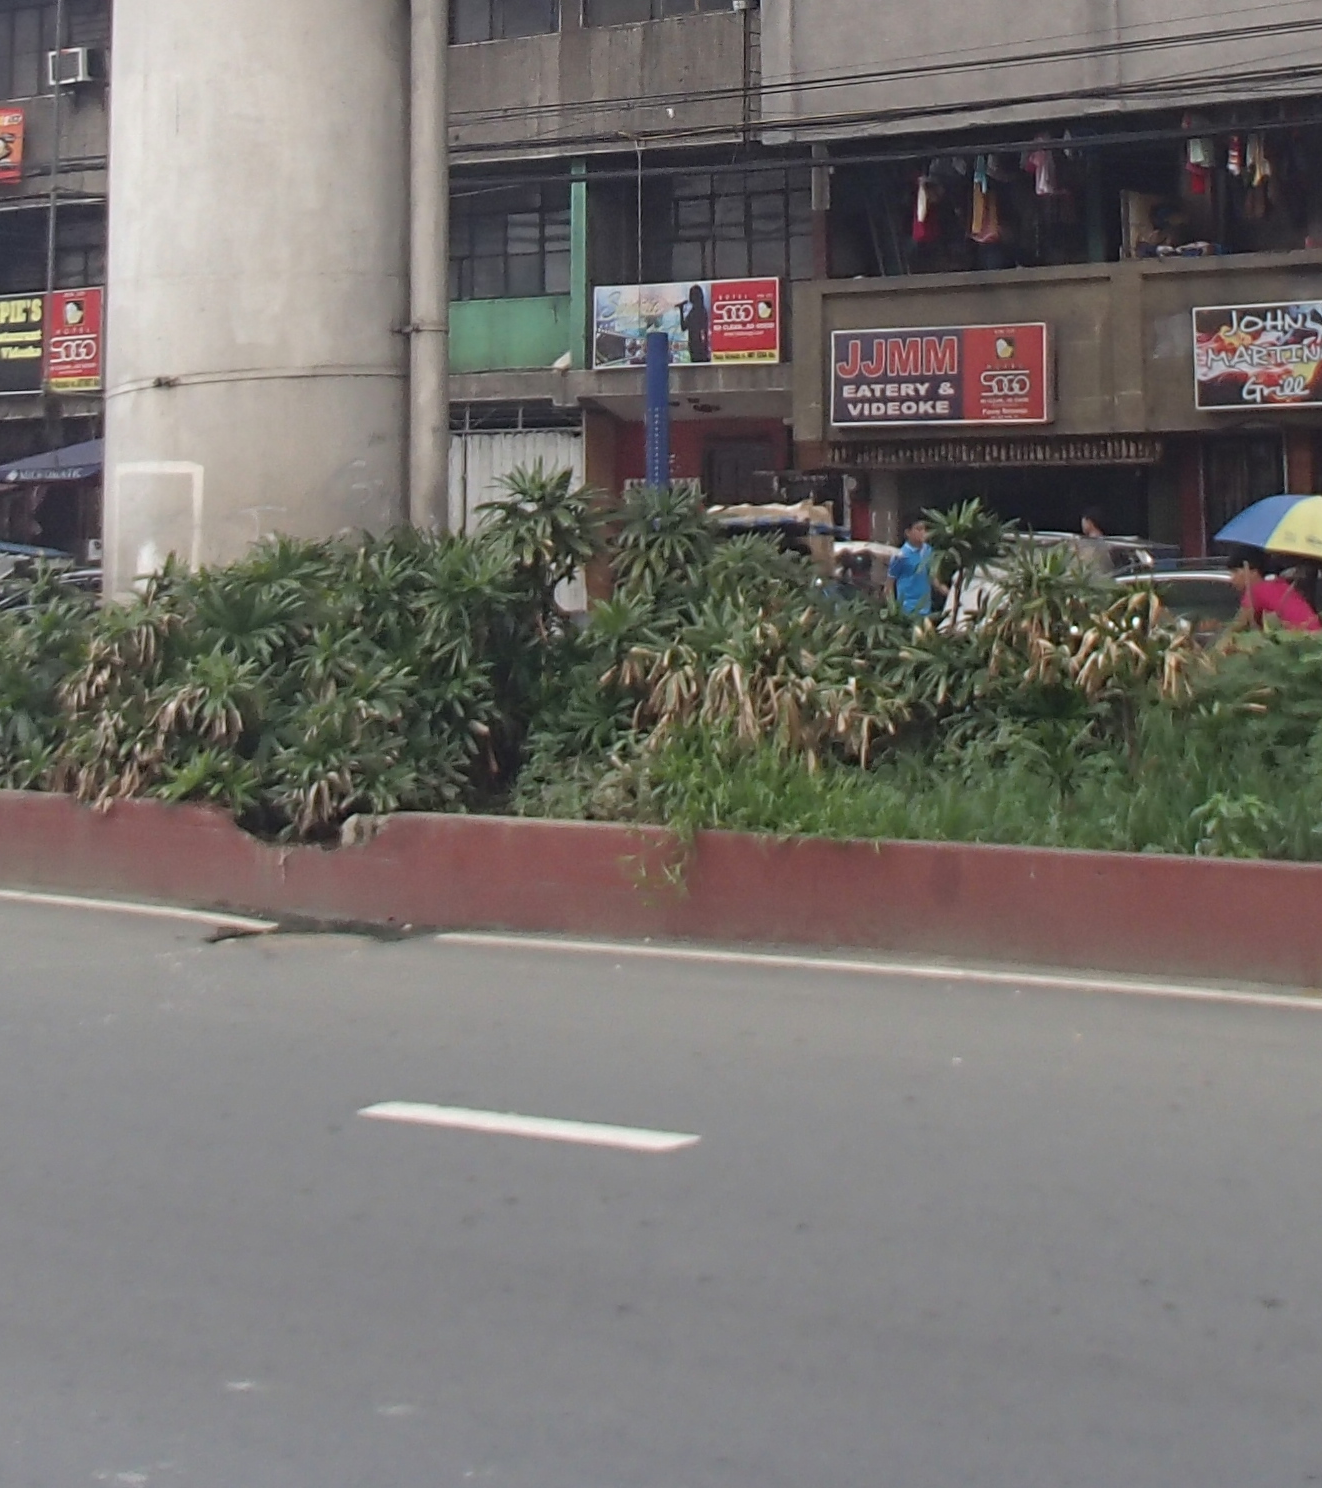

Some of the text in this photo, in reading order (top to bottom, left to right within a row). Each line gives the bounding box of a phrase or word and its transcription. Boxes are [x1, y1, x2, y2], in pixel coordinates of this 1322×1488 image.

[712, 299, 754, 323] SOGO
[1224, 309, 1304, 336] JOHN
[49, 333, 98, 363] SOGO
[836, 336, 958, 378] JJMM
[842, 381, 955, 398] EATERY &
[980, 370, 1030, 396] SOGO
[1242, 375, 1310, 403] Grill
[847, 400, 950, 417] VIDEOKE
